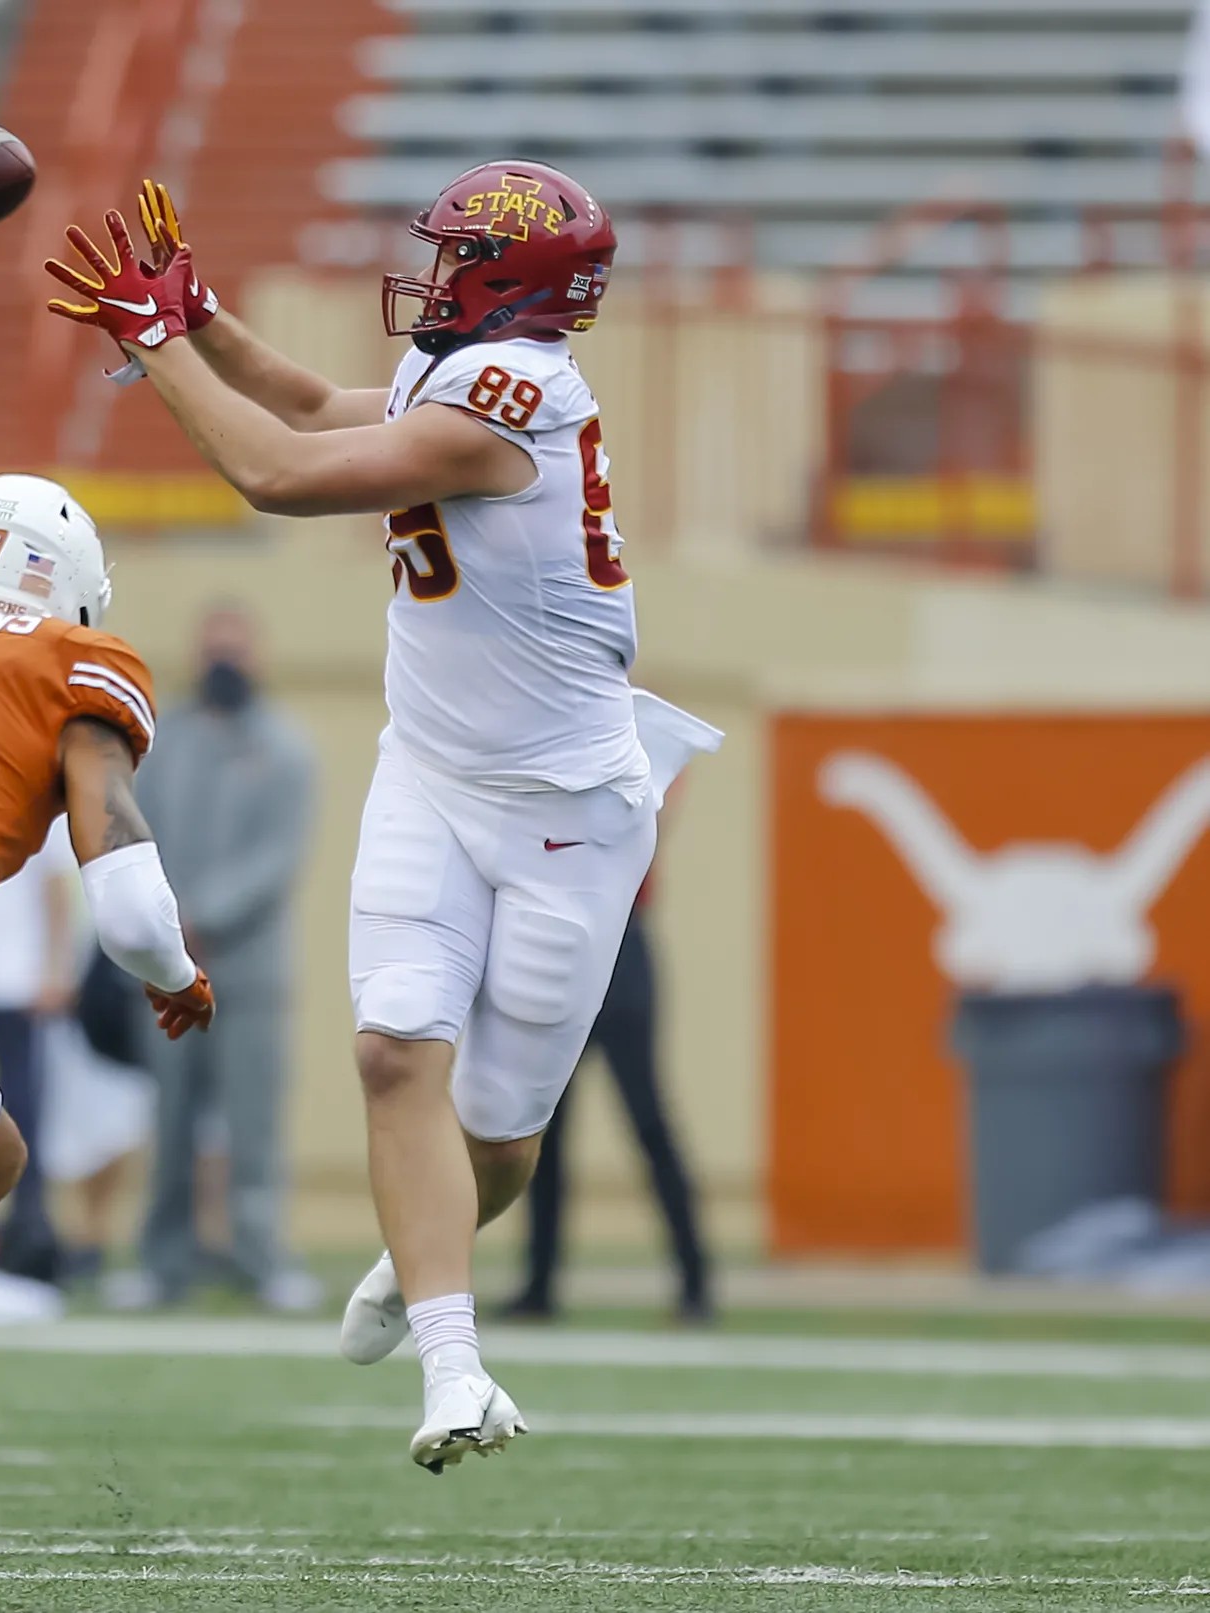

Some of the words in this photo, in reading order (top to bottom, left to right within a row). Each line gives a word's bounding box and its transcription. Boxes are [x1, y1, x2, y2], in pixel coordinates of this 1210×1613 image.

[464, 191, 565, 236] STATE
[566, 288, 587, 301] UNITY
[468, 365, 543, 430] 89
